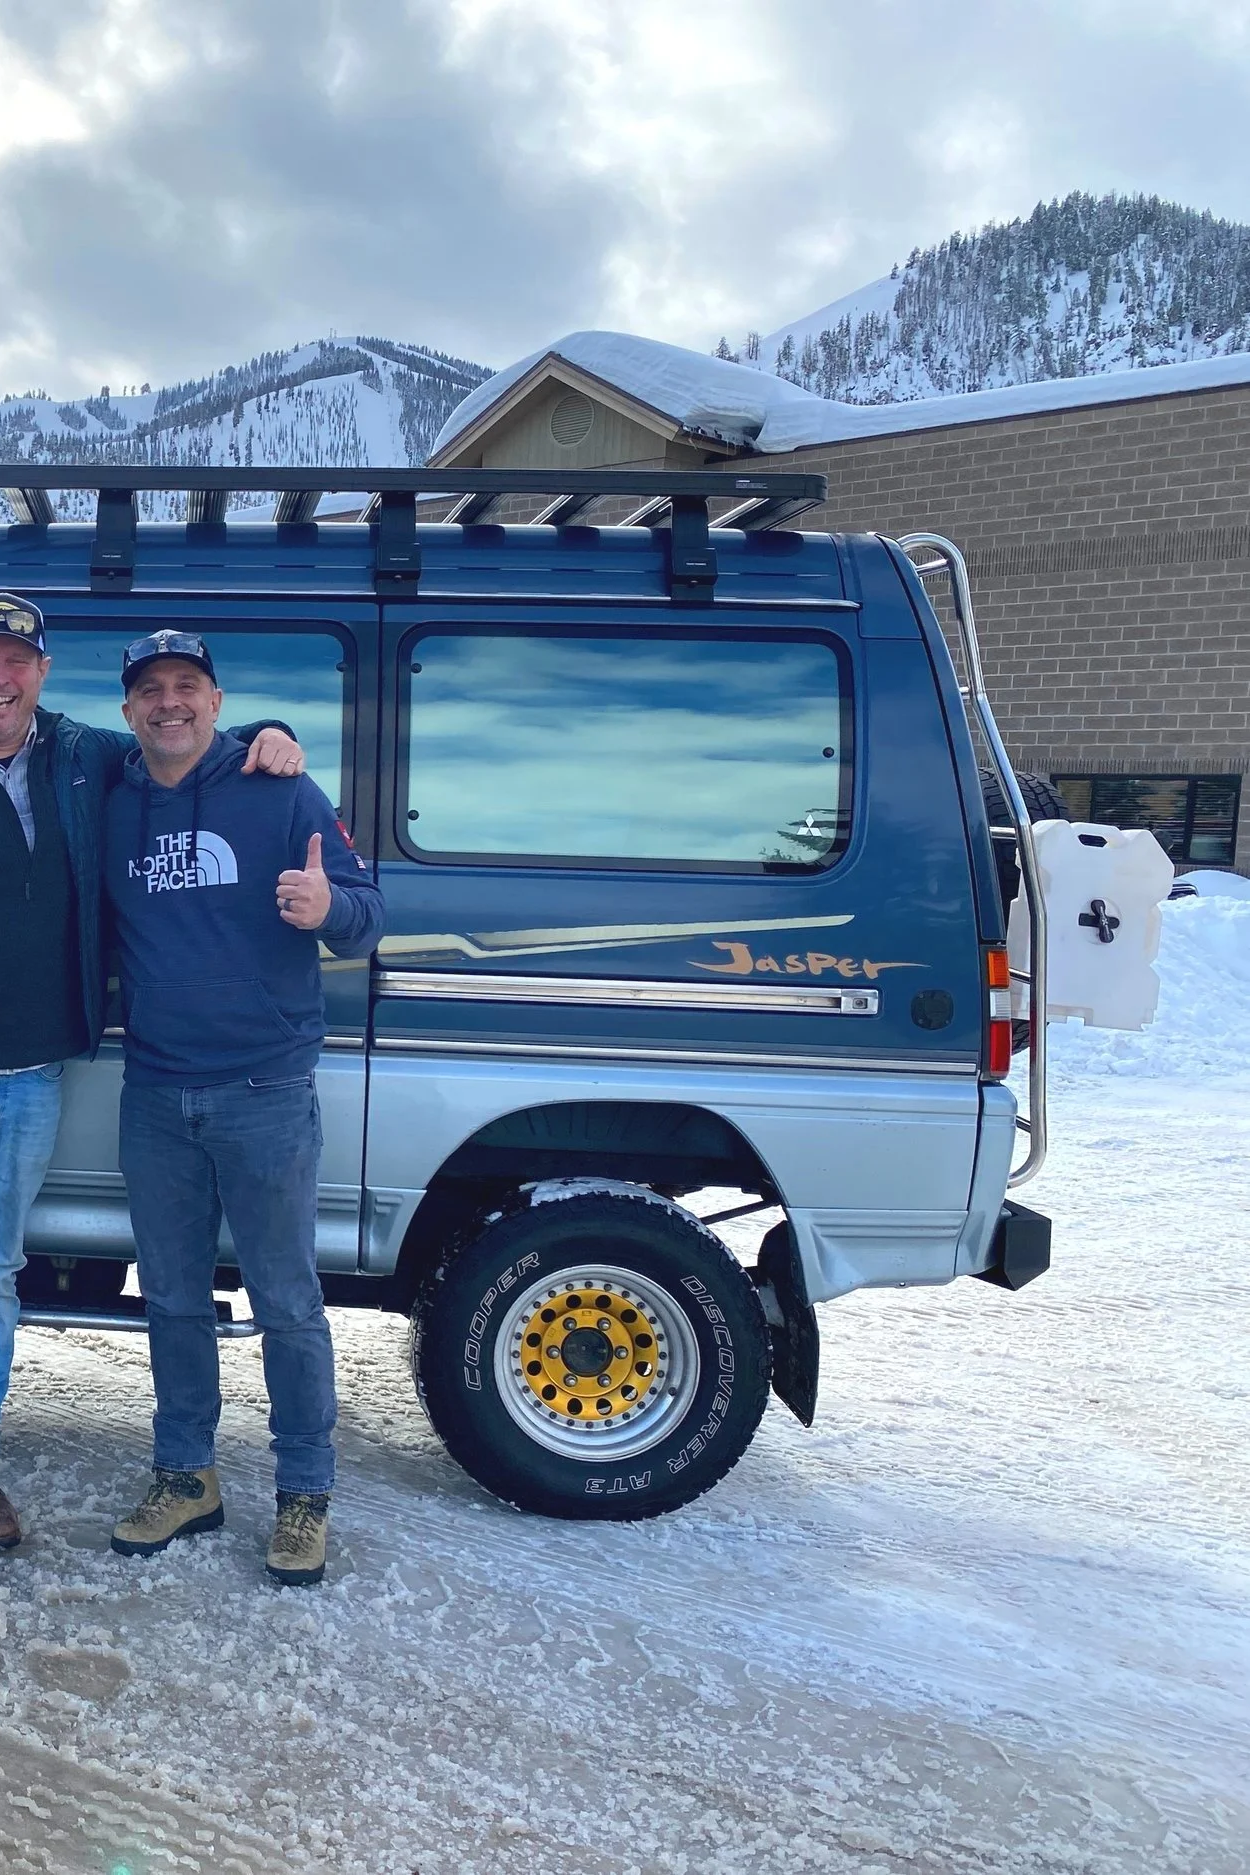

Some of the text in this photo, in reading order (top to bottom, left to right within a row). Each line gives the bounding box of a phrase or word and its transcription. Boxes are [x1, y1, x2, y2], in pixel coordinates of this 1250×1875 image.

[147, 869, 197, 894] FACE
[155, 831, 193, 853] THE
[463, 1251, 540, 1392] COOPER
[584, 1274, 736, 1495] DISCOVERER AT3
